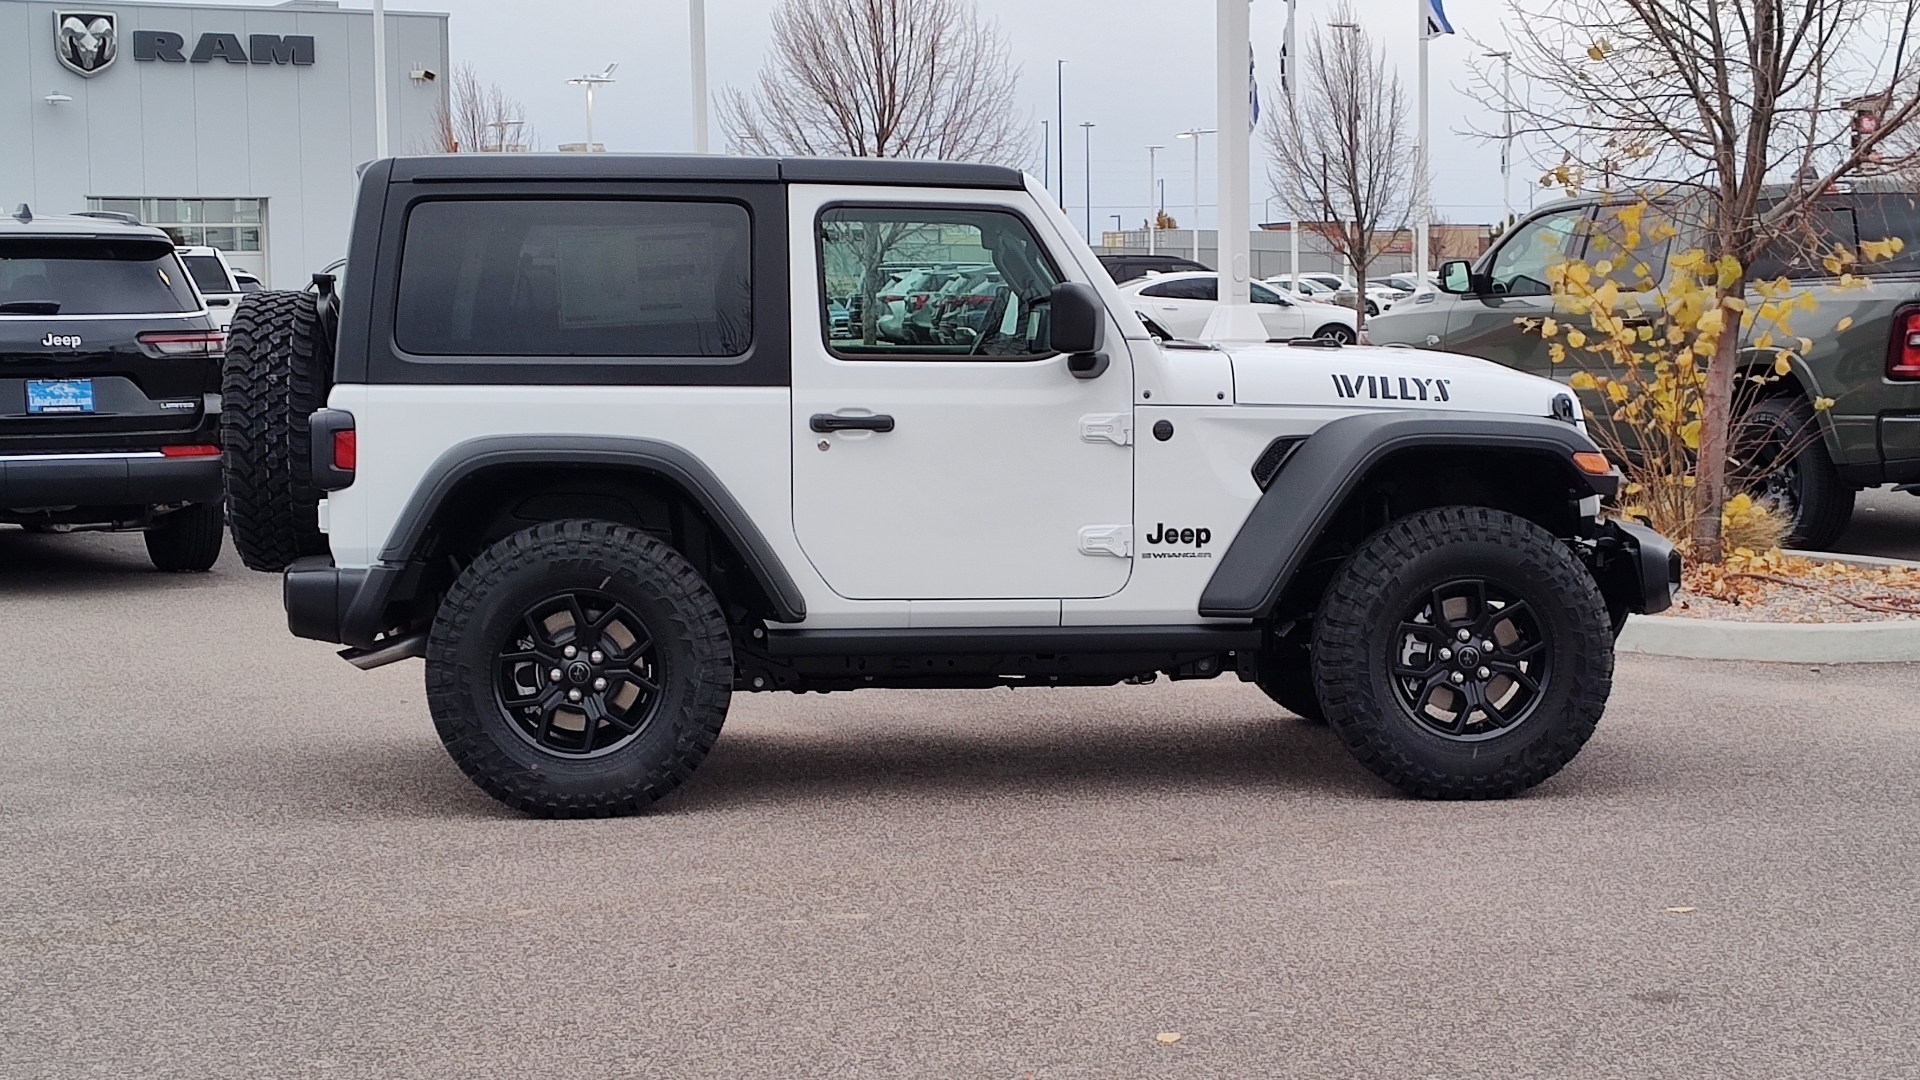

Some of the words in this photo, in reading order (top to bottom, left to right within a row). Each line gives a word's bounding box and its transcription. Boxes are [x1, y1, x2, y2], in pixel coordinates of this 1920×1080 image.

[133, 30, 315, 65] RAM
[42, 333, 81, 348] Jeep
[1331, 374, 1450, 401] WILLYS
[1146, 523, 1211, 548] Jeep
